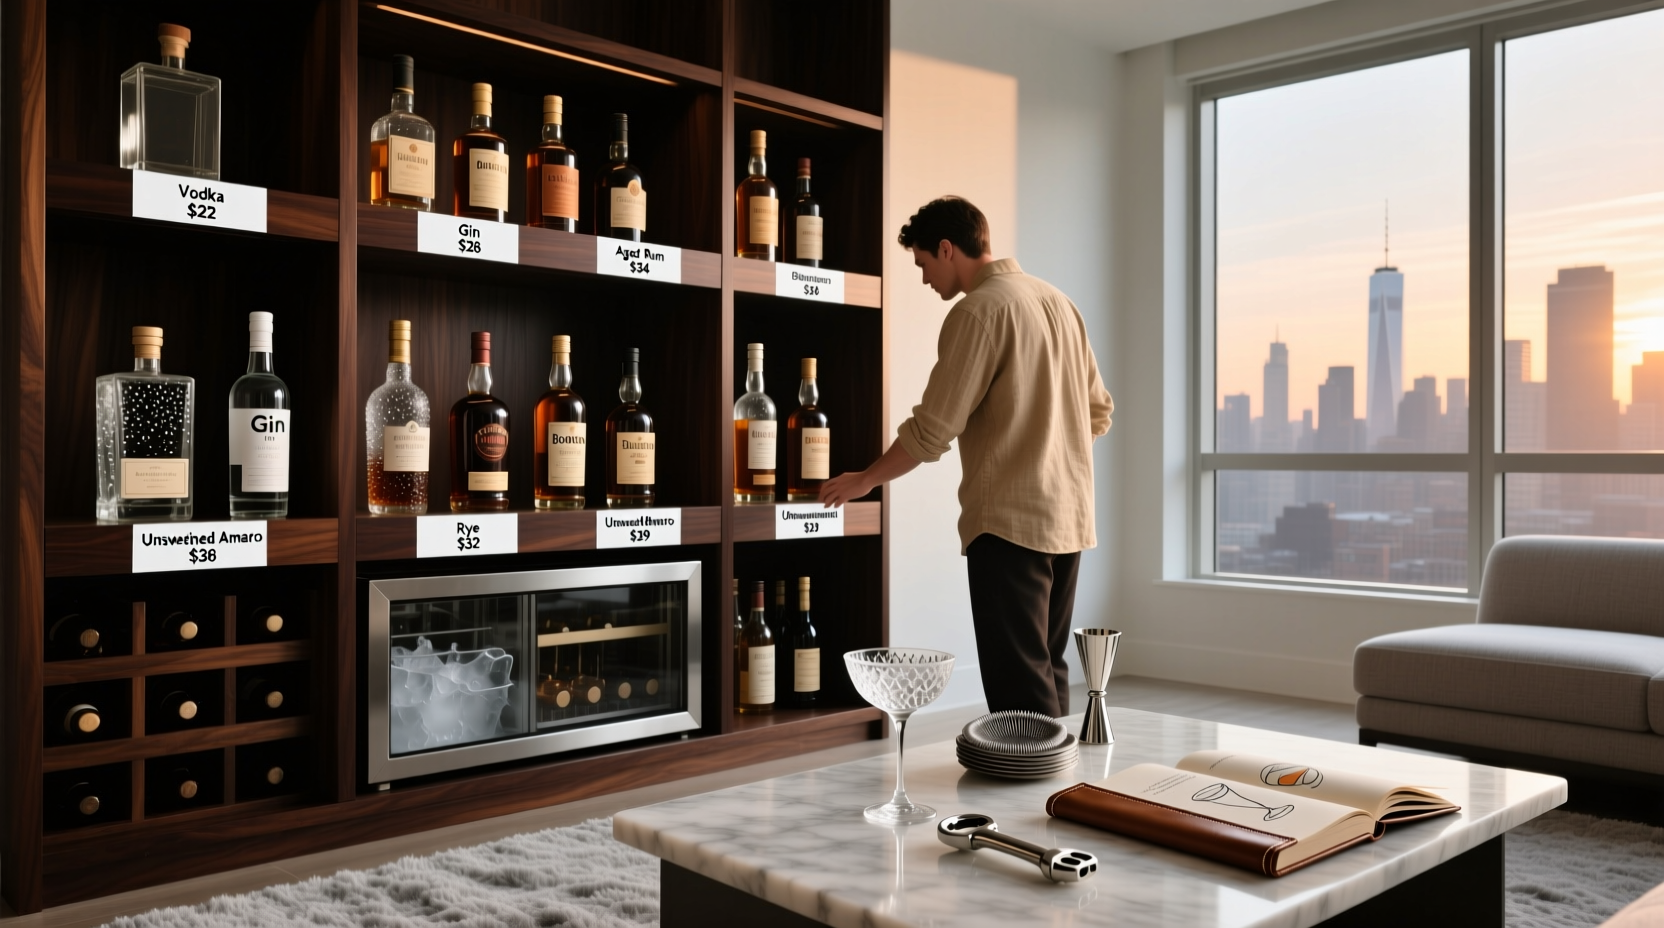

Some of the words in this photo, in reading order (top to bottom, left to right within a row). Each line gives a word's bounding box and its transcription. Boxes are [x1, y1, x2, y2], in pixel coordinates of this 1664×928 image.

[179, 184, 224, 203] Vodka
[187, 203, 216, 219] $22
[459, 224, 480, 238] Gin
[630, 261, 649, 273] $34
[251, 415, 284, 432] Gin
[219, 531, 262, 543] Amaro
[457, 523, 479, 537] Rye
[457, 537, 480, 551] $32
[189, 548, 216, 564] $38
